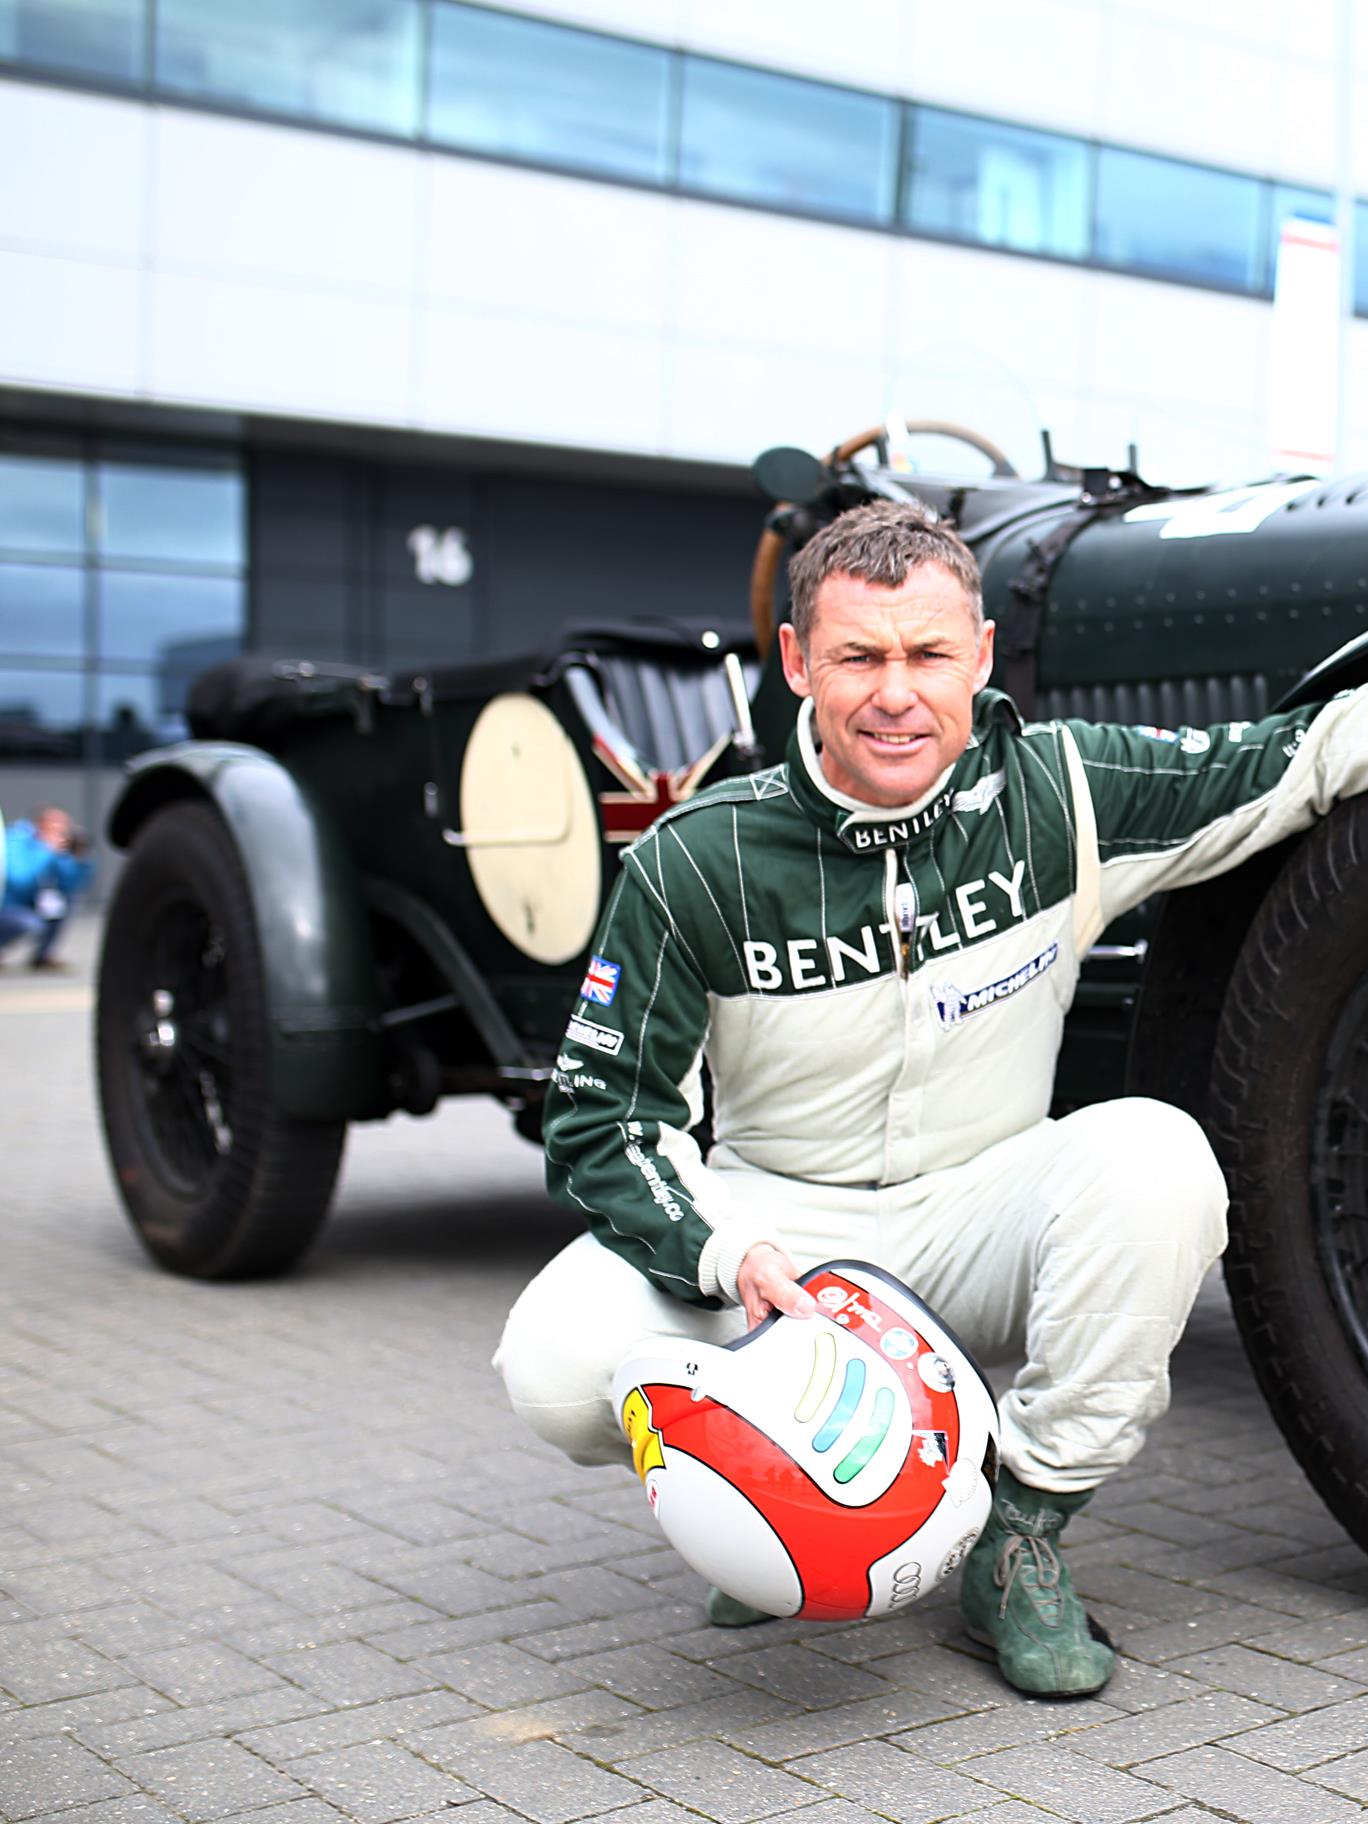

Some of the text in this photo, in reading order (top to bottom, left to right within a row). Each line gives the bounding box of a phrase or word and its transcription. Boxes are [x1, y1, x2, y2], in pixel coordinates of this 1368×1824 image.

[406, 525, 473, 587] 16
[743, 860, 1026, 990] BENTLEY
[967, 943, 1058, 1012] MICHELIN
